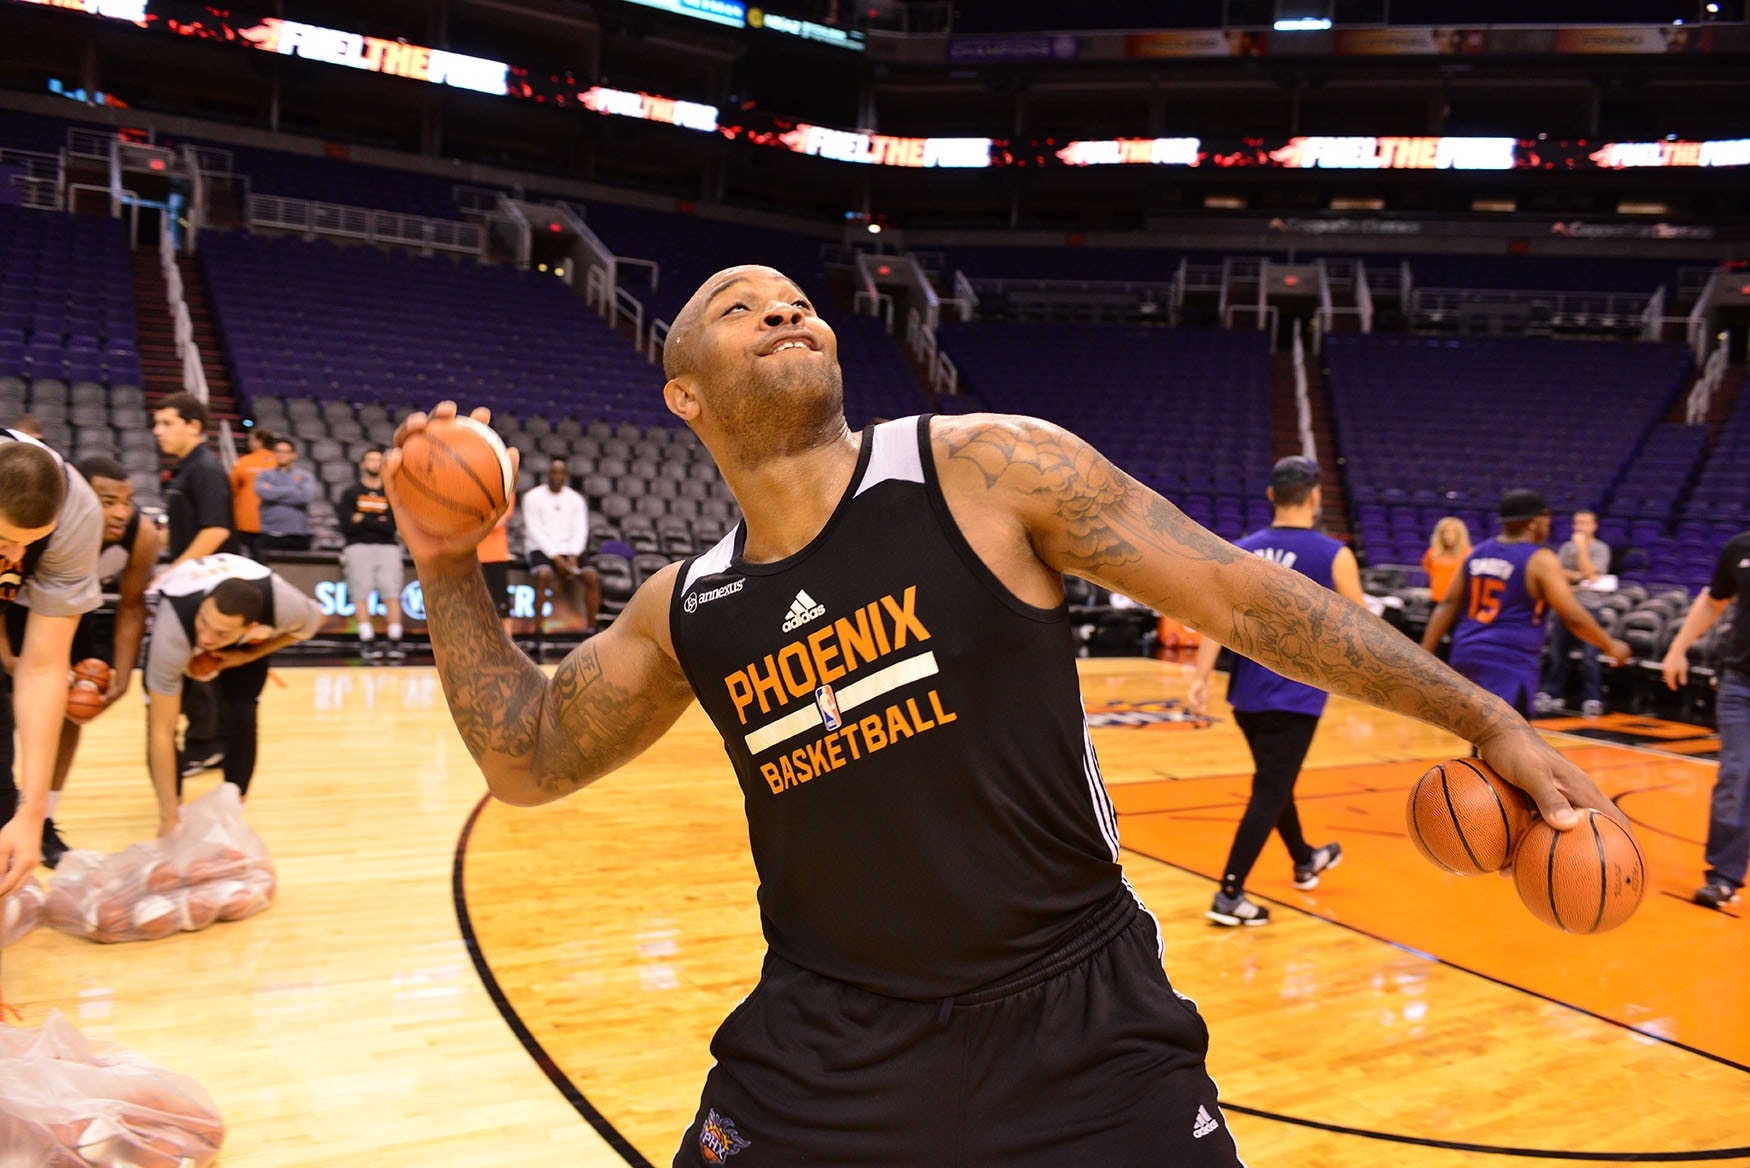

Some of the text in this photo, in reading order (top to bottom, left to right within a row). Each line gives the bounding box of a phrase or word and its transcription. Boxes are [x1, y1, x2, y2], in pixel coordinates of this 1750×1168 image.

[698, 579, 744, 604] annexus
[1467, 576, 1507, 624] 15
[782, 603, 826, 633] adidas
[724, 585, 932, 725] PHOENIX
[760, 689, 958, 795] BASKETBALL
[702, 1132, 726, 1160] PHX
